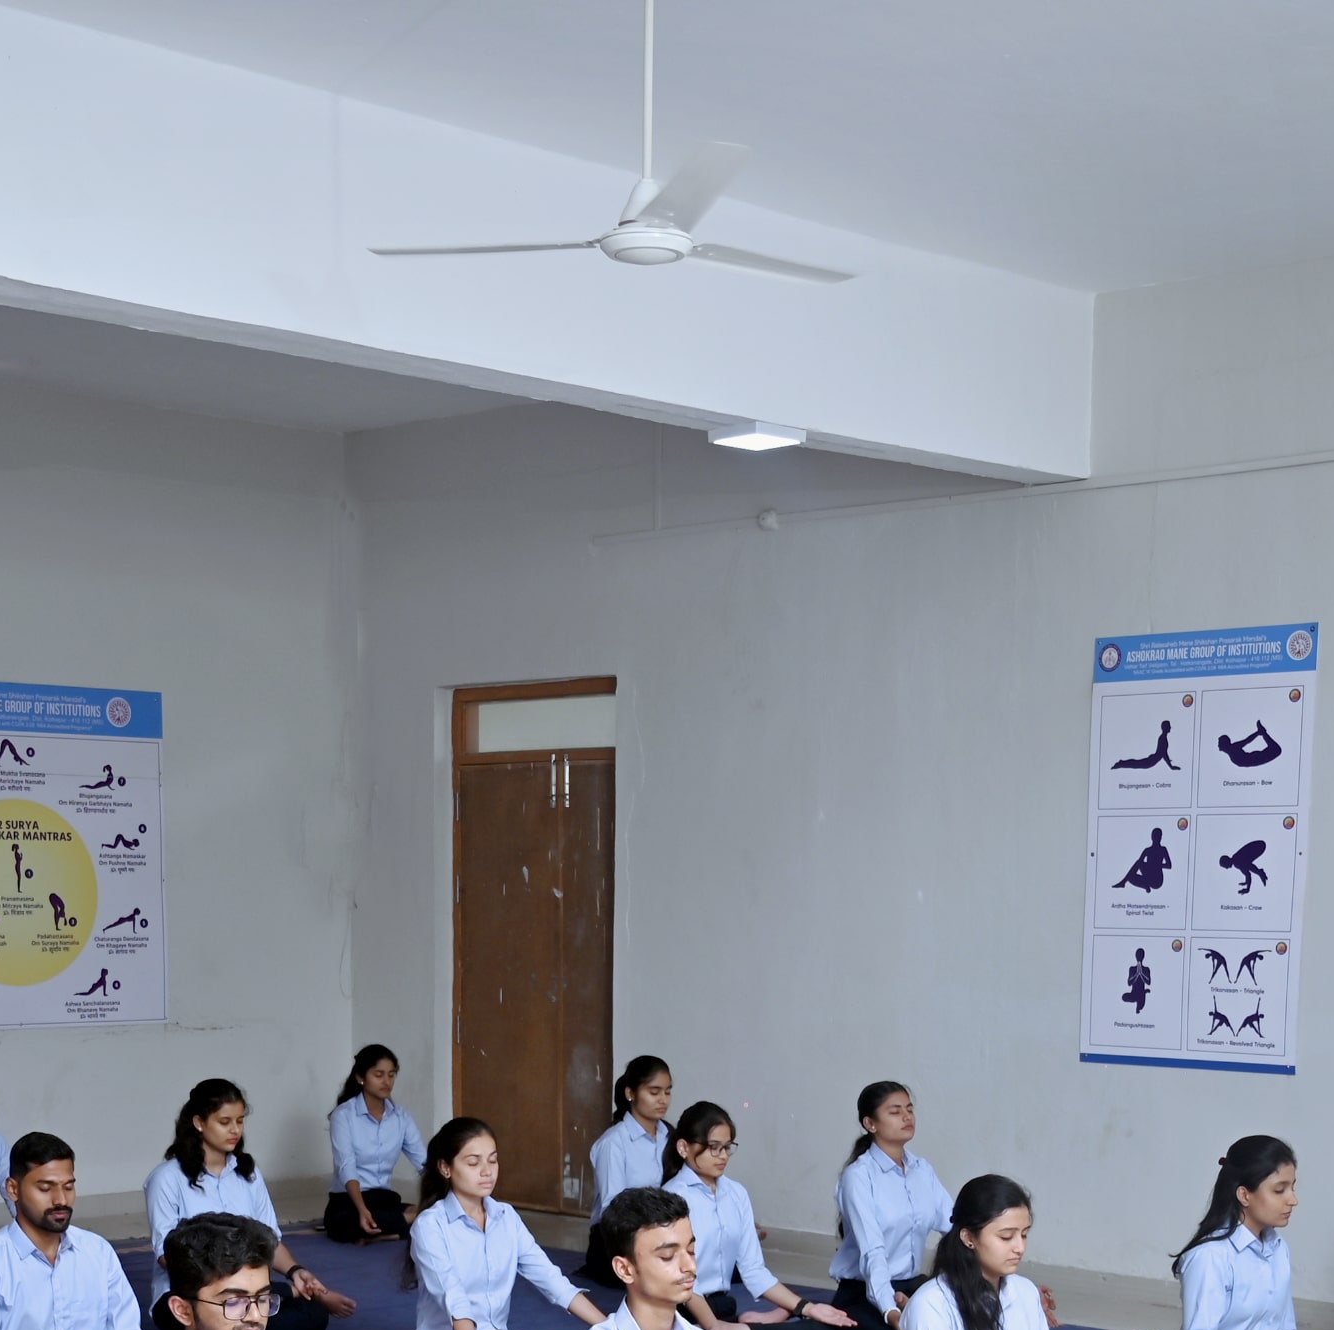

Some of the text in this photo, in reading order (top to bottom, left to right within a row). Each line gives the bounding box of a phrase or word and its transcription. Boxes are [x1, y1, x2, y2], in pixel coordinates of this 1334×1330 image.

[1126, 649, 1165, 663] ASHOKRAO
[1166, 647, 1189, 660] MANE
[1189, 645, 1216, 659] GROUP
[1216, 644, 1227, 657] OF
[1228, 641, 1281, 656] INSTITUTIONS
[4, 700, 33, 714] GROUP
[34, 702, 45, 714] OF
[46, 702, 101, 718] INSTITUTIONS
[5, 820, 39, 830] SURYA
[22, 831, 72, 842] MANTRAS
